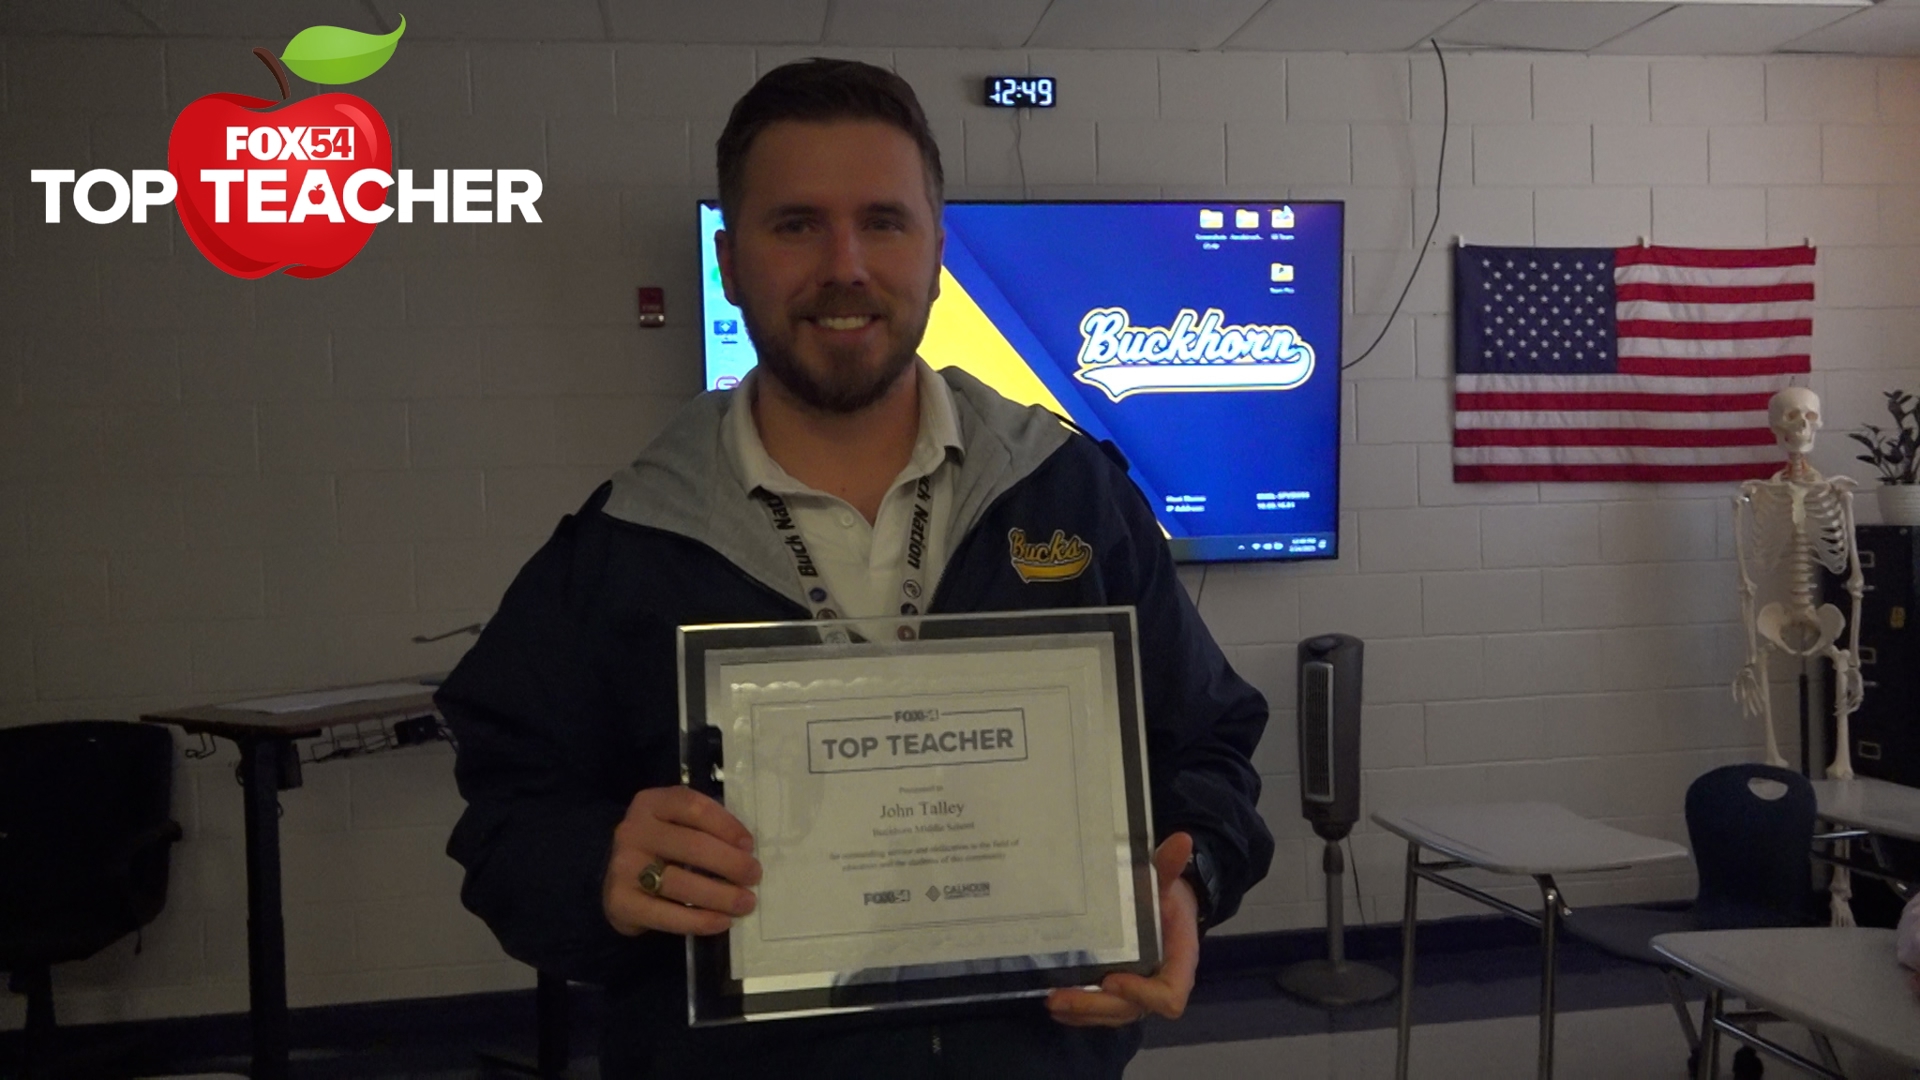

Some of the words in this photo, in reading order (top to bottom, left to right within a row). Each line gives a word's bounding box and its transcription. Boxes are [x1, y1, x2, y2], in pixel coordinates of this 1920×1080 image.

[989, 78, 1052, 106] 12:49
[1080, 308, 1302, 366] Buckhorn
[916, 475, 932, 502] uck
[906, 503, 929, 570] Nation
[1008, 527, 1084, 563] Bucks
[784, 534, 819, 578] Buck
[821, 737, 879, 760] TOP
[886, 728, 1014, 756] TEACHER
[879, 804, 914, 819] John
[919, 801, 965, 817] Talley
